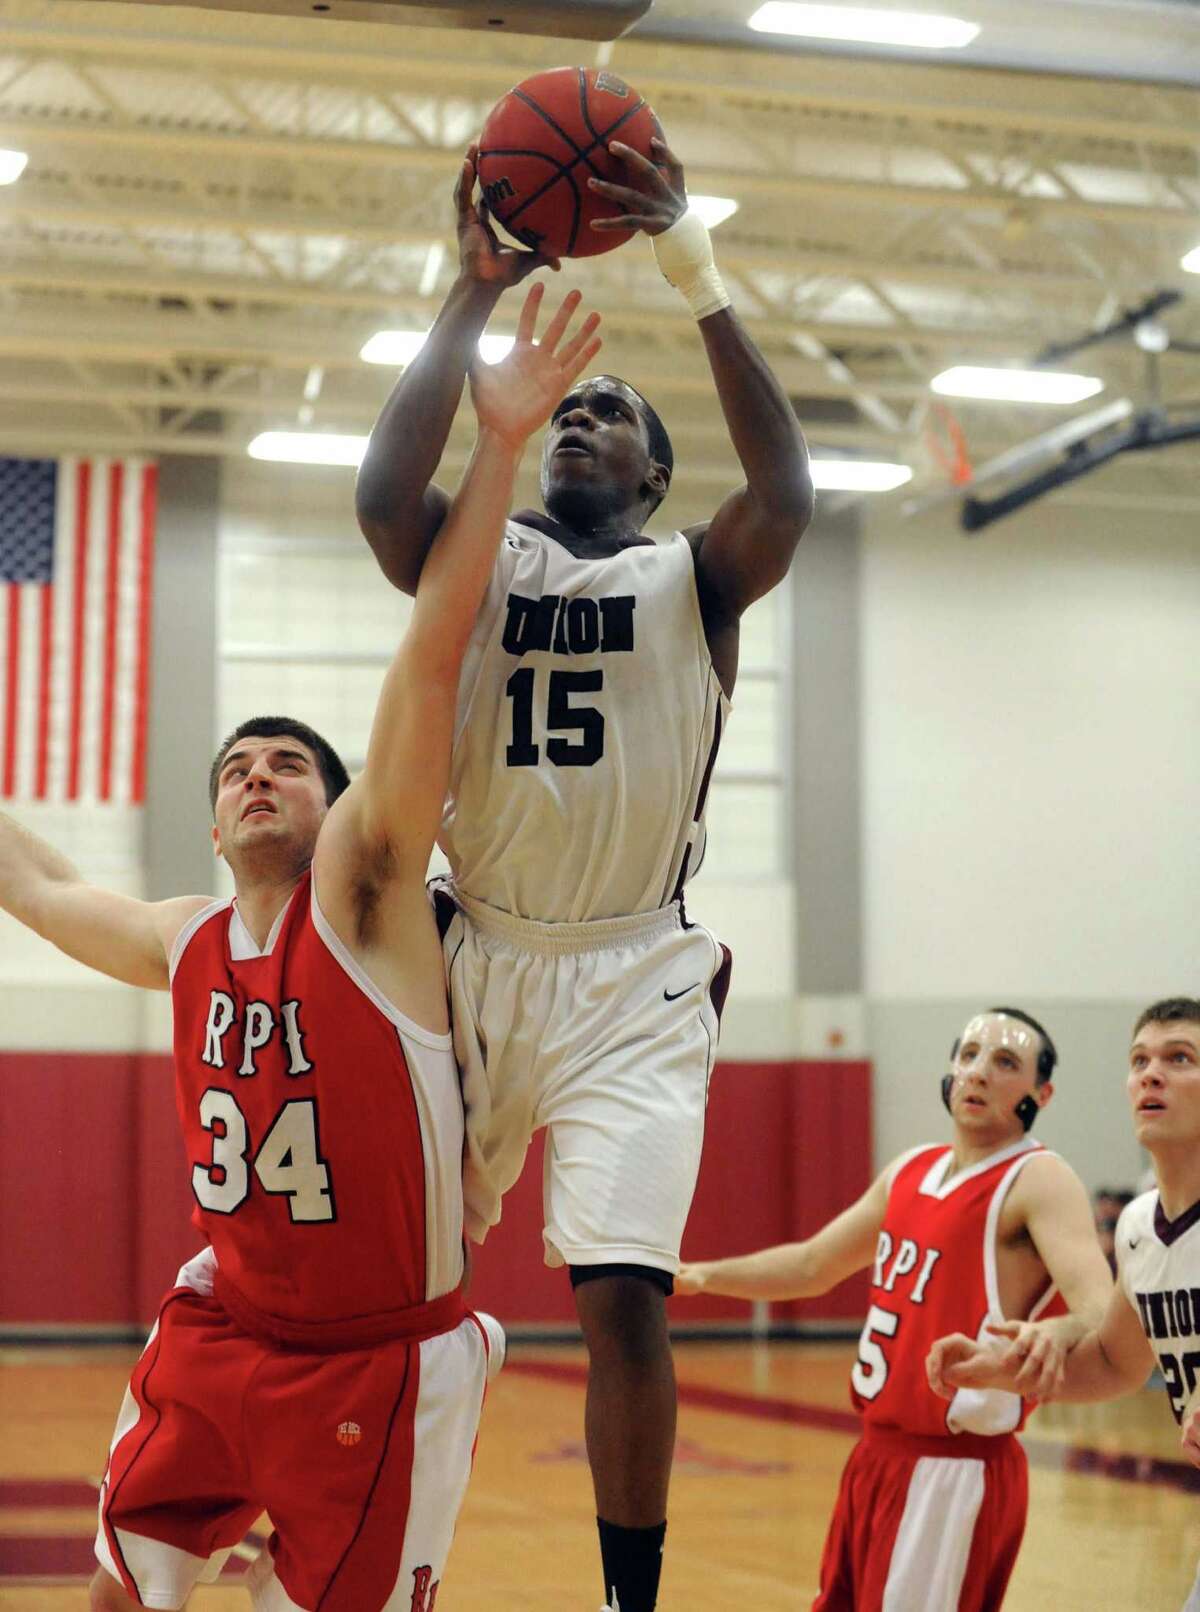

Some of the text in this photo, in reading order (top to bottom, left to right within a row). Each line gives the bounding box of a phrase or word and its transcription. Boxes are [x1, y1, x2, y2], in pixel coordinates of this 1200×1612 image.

[502, 593, 635, 656] UNION
[506, 668, 604, 766] 15
[200, 990, 314, 1076] RPI
[191, 1087, 337, 1224] 34
[872, 1231, 942, 1303] RPI
[852, 1304, 900, 1400] 5
